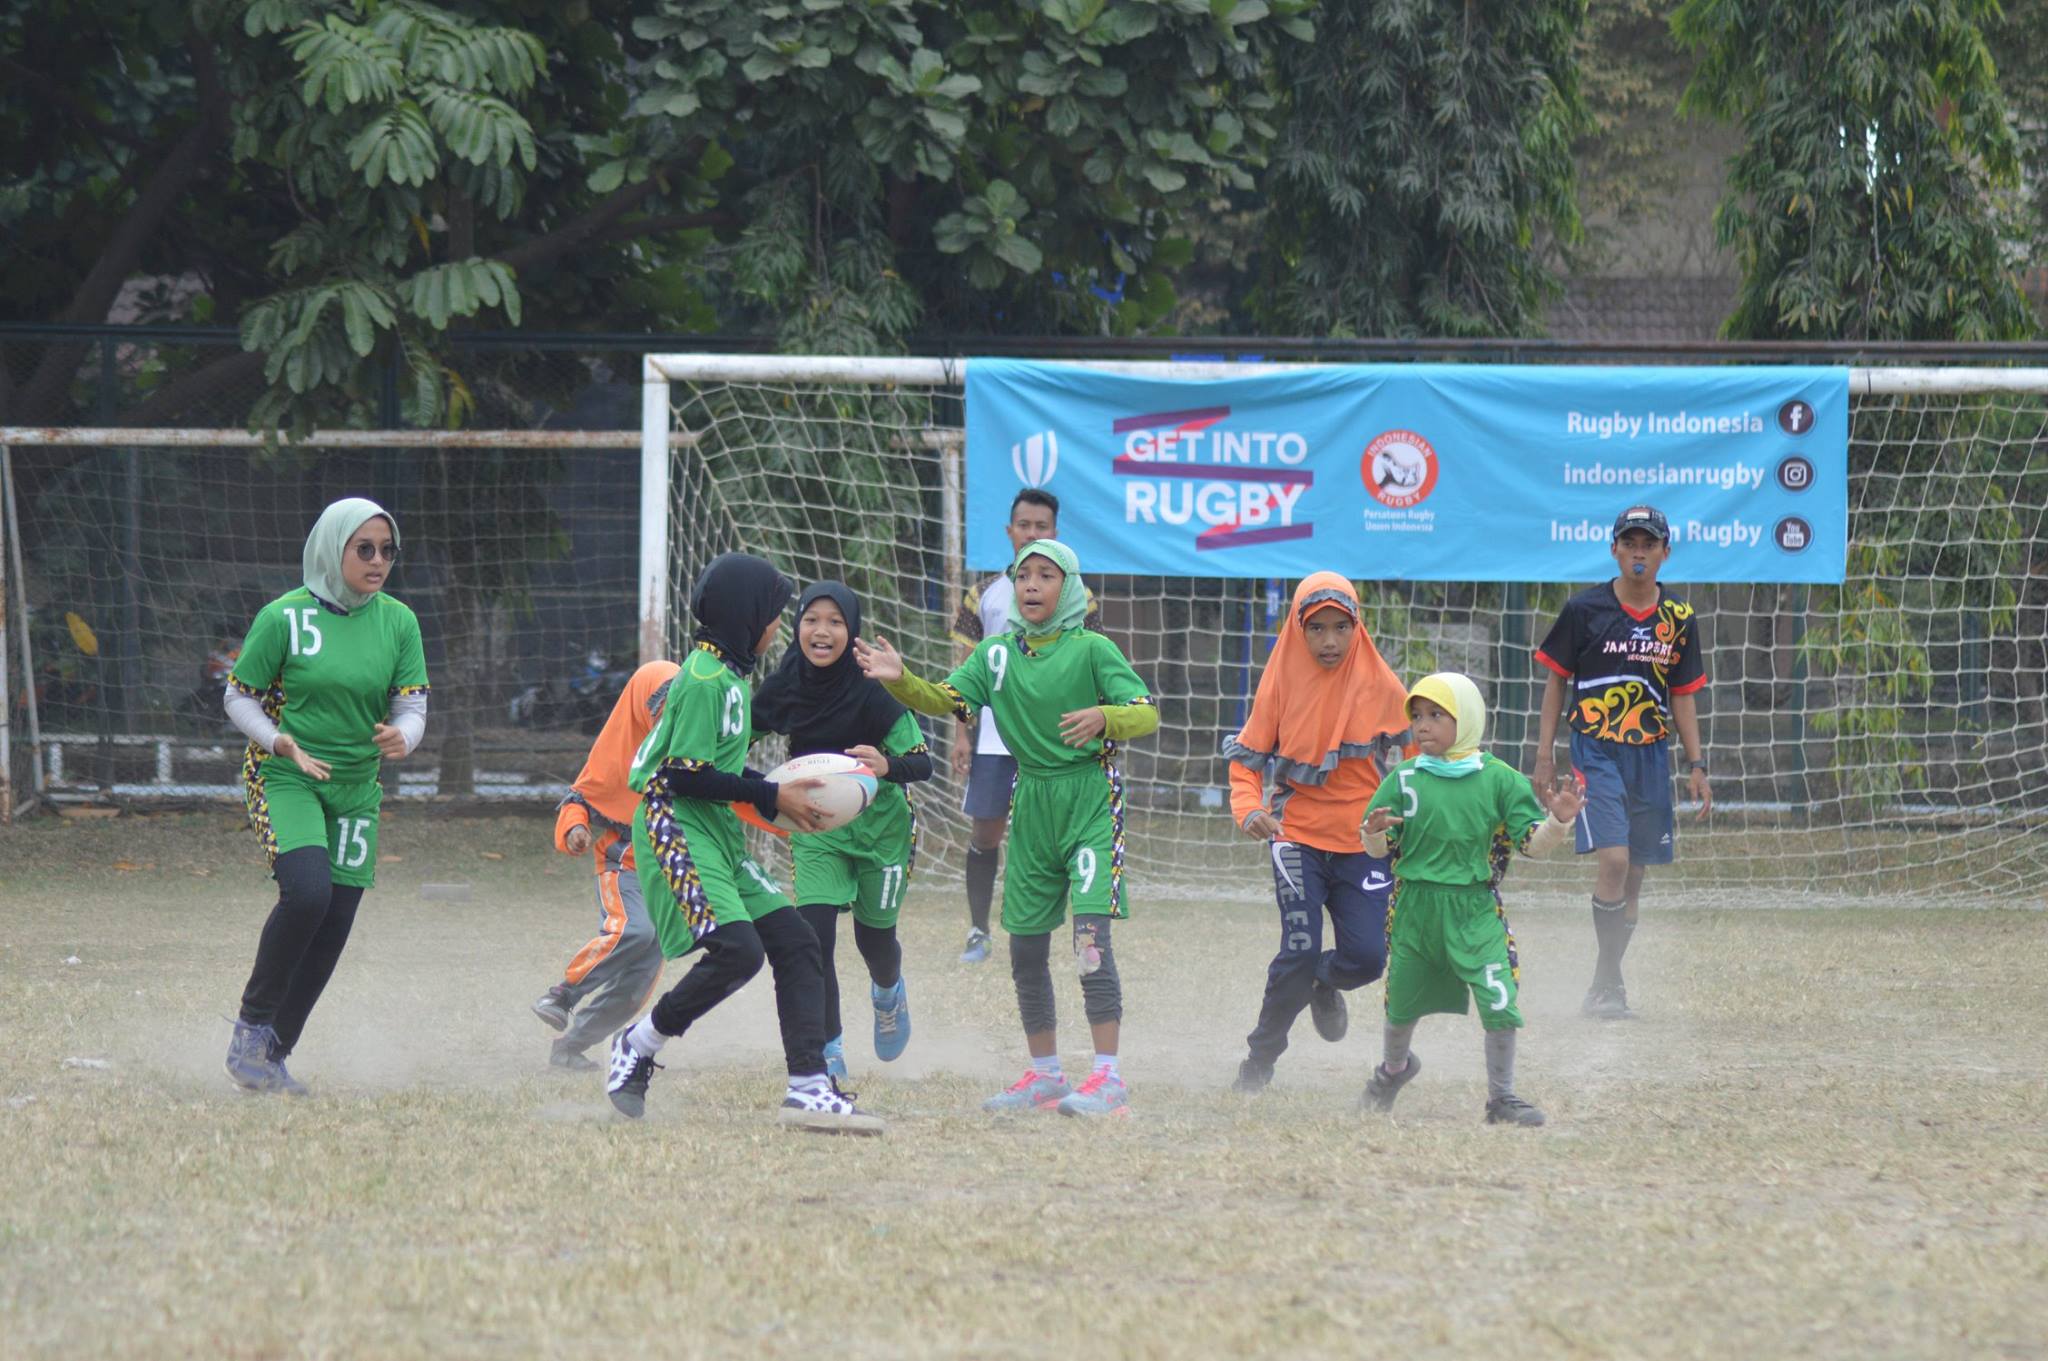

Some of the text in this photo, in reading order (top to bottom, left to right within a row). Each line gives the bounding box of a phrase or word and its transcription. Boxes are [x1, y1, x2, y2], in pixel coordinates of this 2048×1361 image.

[1125, 431, 1307, 464] GET INTO
[1567, 411, 1764, 439] Rugby Indonesia
[1377, 491, 1421, 507] RUGBY
[1564, 463, 1765, 490] indonesianrugby
[1125, 481, 1305, 526] RUGBY
[1687, 520, 1762, 548] Rugby
[283, 608, 322, 656] 15
[1602, 640, 1637, 653] JAM'S
[987, 644, 1008, 691] 9
[723, 686, 743, 737] 13
[1398, 769, 1418, 817] 5
[336, 818, 371, 867] 15
[879, 866, 903, 909] 11
[1077, 848, 1096, 893] 9
[1485, 963, 1509, 1011] 5
